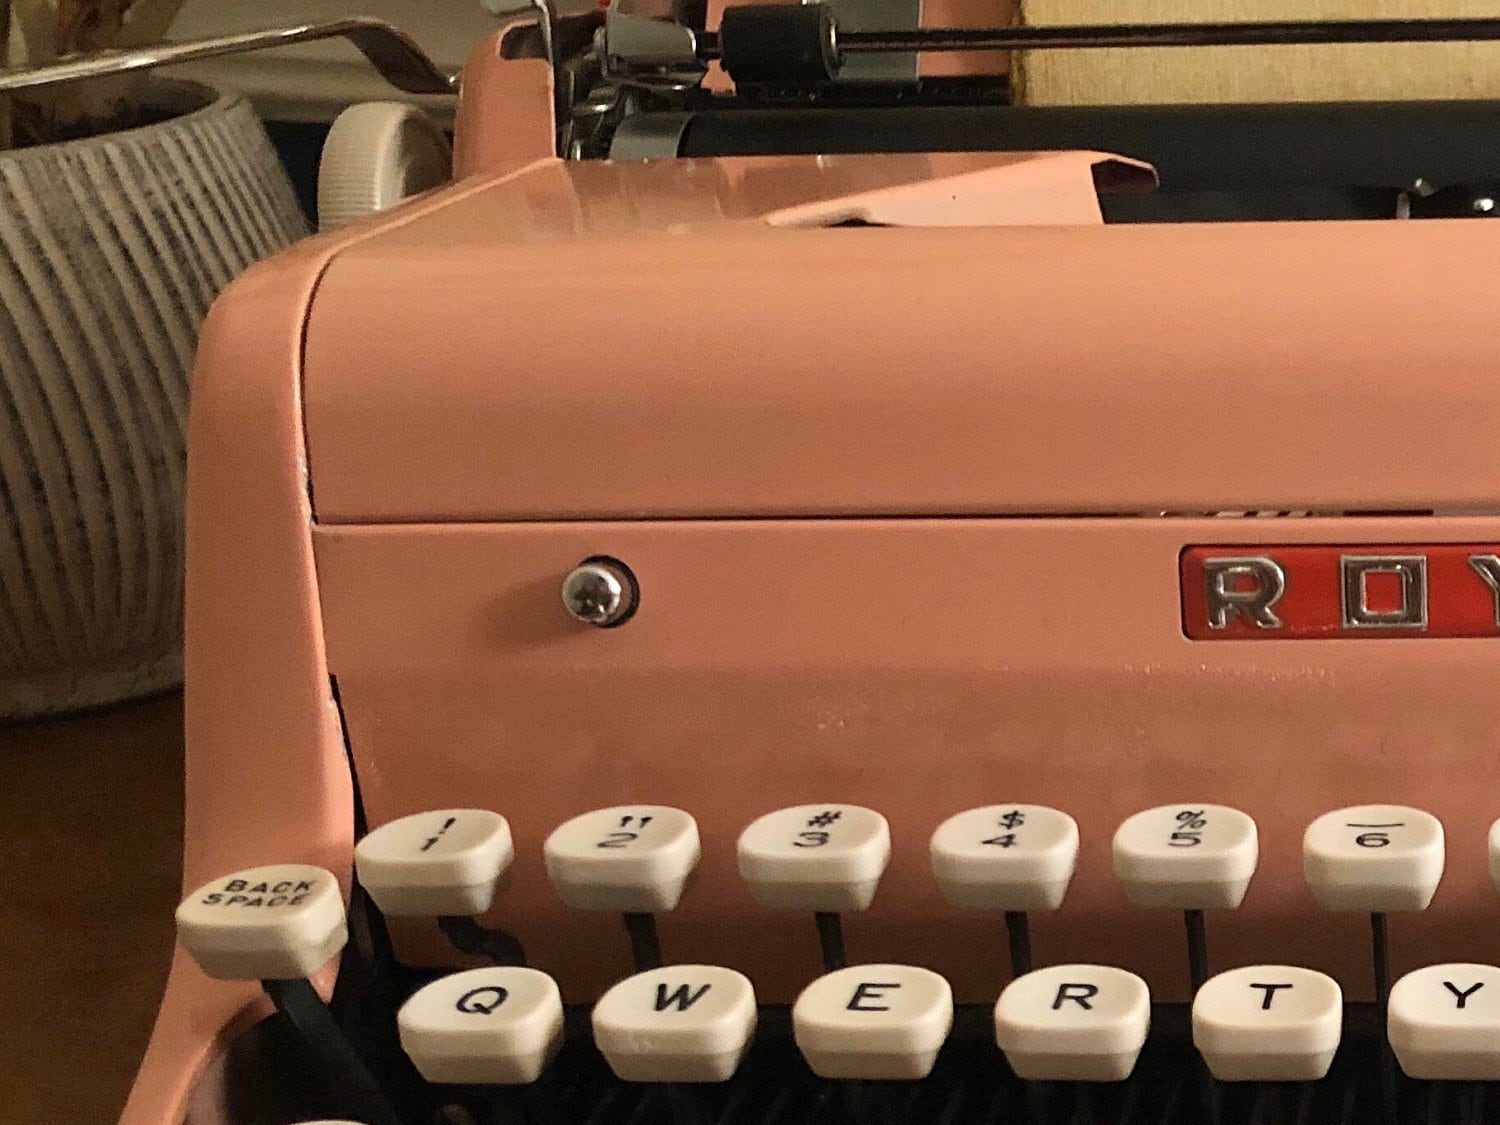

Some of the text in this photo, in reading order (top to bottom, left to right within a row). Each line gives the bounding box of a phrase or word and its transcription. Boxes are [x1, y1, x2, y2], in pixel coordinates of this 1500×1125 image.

[438, 817, 457, 835] !
[807, 810, 842, 828] #
[998, 810, 1025, 831] $
[1175, 810, 1208, 830] %
[596, 832, 639, 849] 2
[792, 831, 831, 849] 3
[981, 833, 1017, 849] 4
[1167, 831, 1202, 848] 5
[1355, 832, 1391, 848] 6
[225, 879, 317, 894] BACK
[201, 892, 310, 908] SPACE
[455, 985, 509, 1016] Q
[653, 983, 712, 1012] W
[845, 982, 902, 1012] E
[1051, 982, 1099, 1011] R
[1249, 982, 1294, 1011] T
[1442, 981, 1485, 1010] Y
